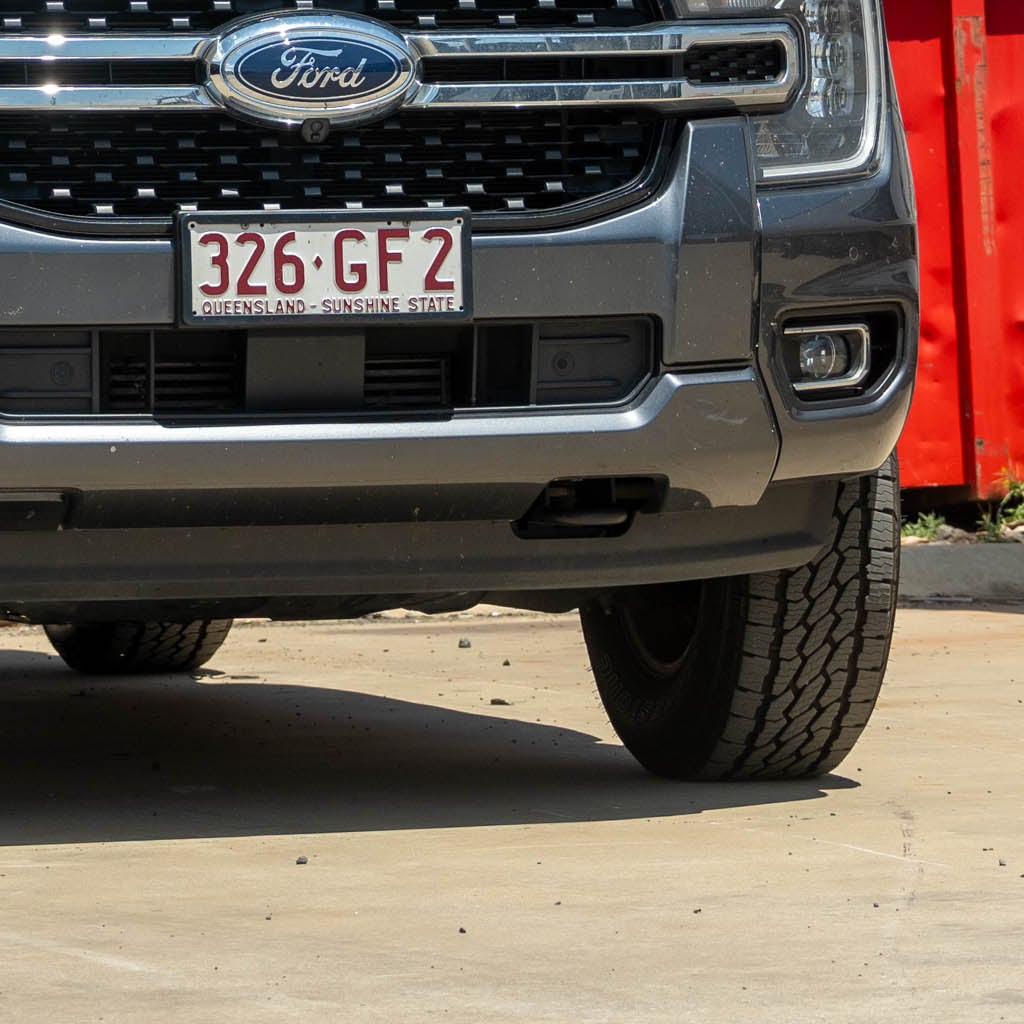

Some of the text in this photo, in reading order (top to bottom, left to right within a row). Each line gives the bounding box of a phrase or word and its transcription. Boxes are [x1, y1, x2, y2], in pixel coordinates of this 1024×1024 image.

[270, 47, 368, 89] Ford
[198, 228, 455, 296] 326 GF2
[202, 299, 305, 315] QUEENSLAND
[322, 297, 400, 313] SUNSHINE
[408, 296, 455, 311] STATE
